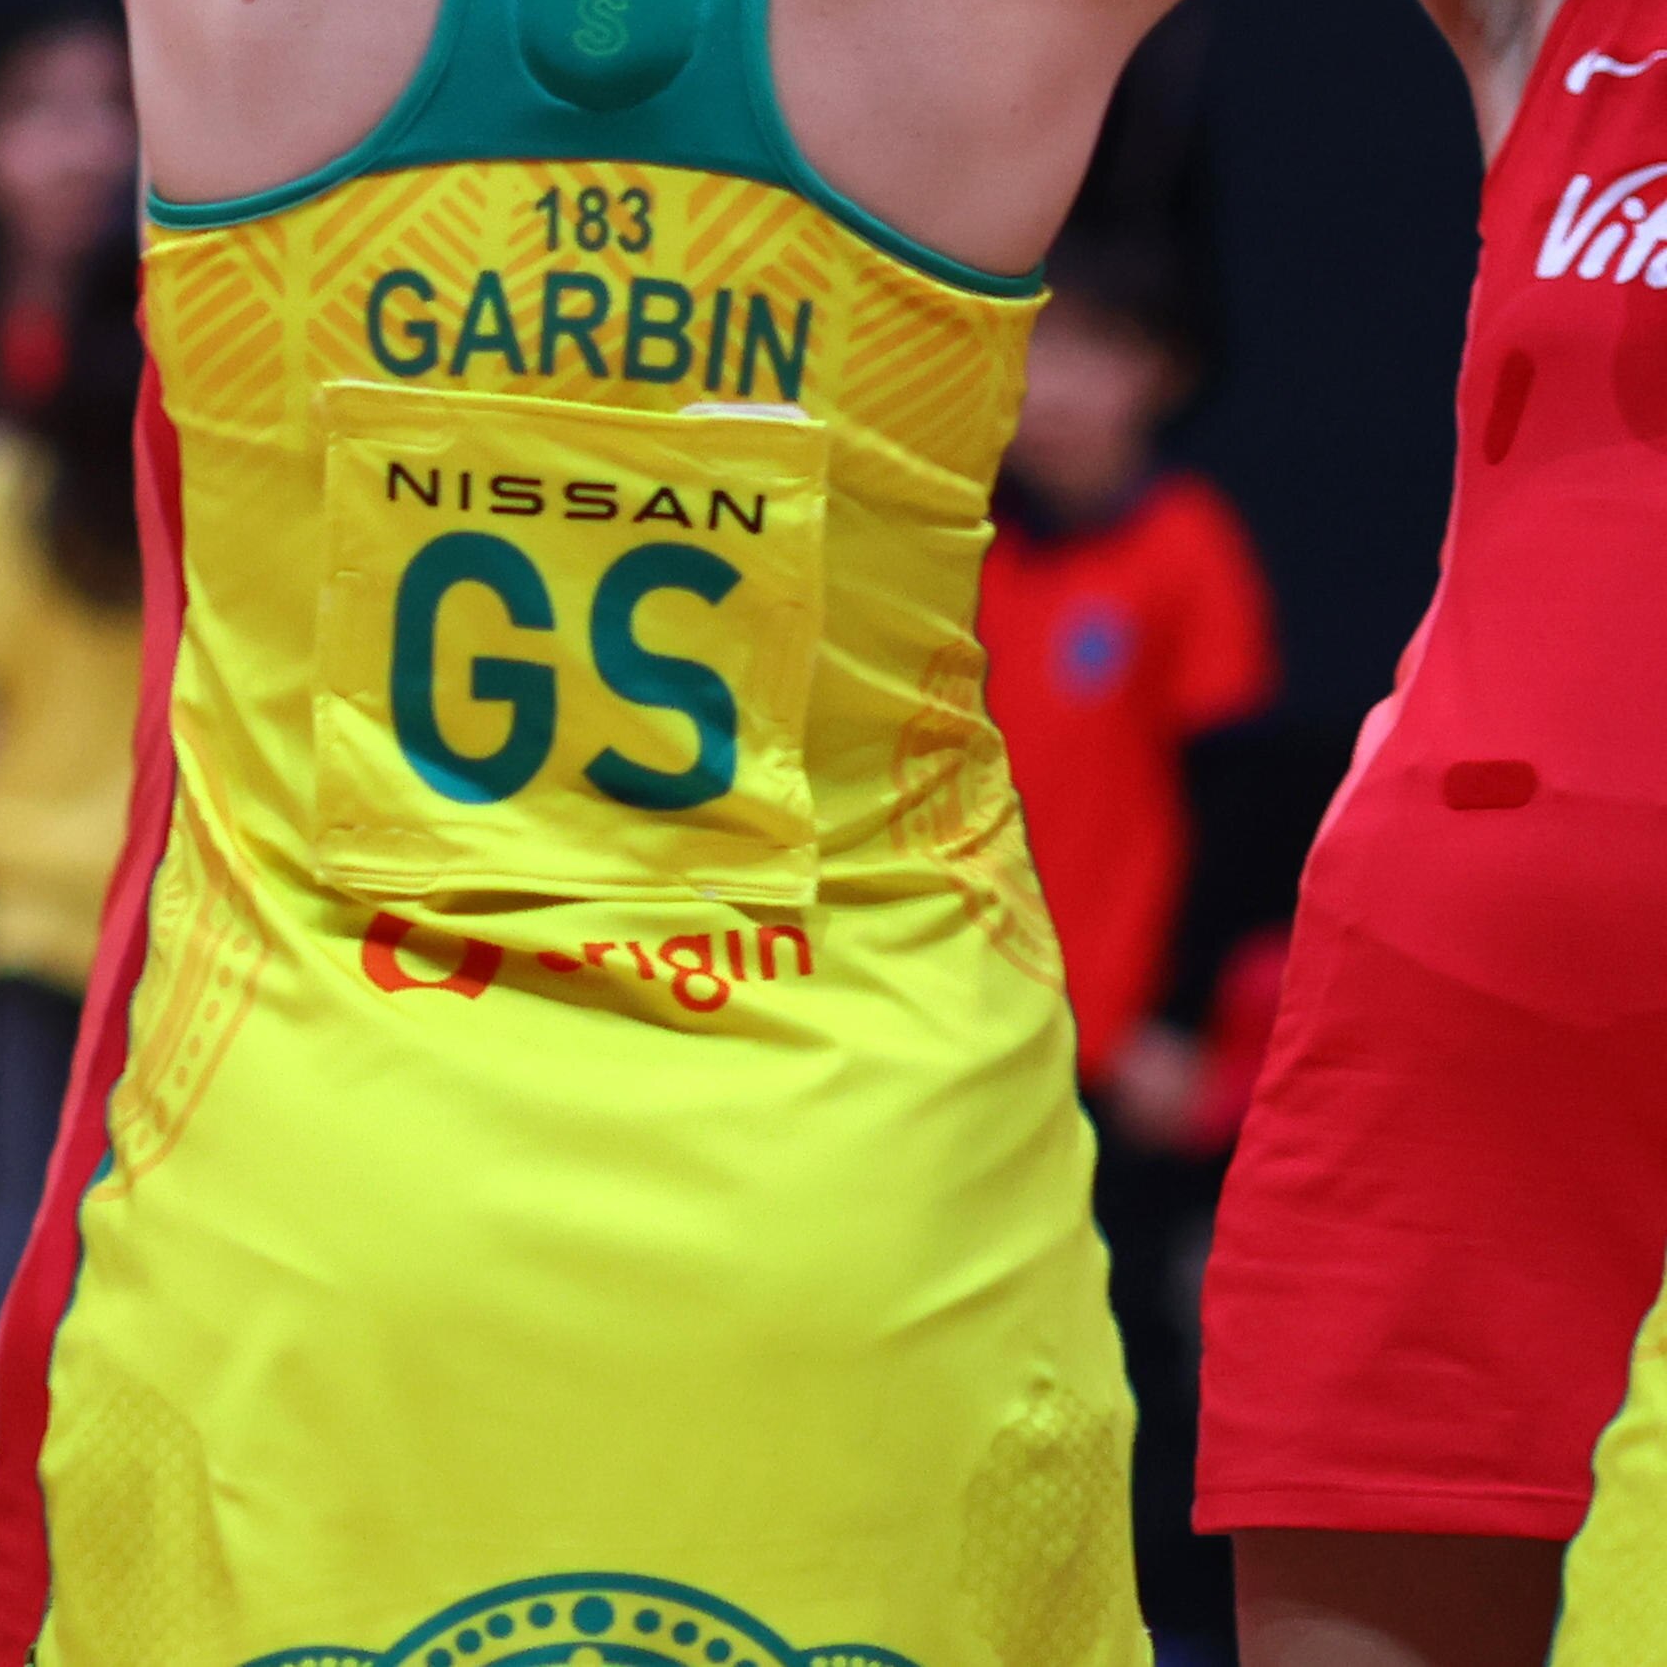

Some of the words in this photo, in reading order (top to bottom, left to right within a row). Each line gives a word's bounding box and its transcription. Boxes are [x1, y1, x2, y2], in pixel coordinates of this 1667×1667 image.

[534, 186, 655, 254] 183
[366, 269, 813, 403] GARBIN
[386, 462, 767, 535] NISSAN
[389, 530, 742, 812] GS
